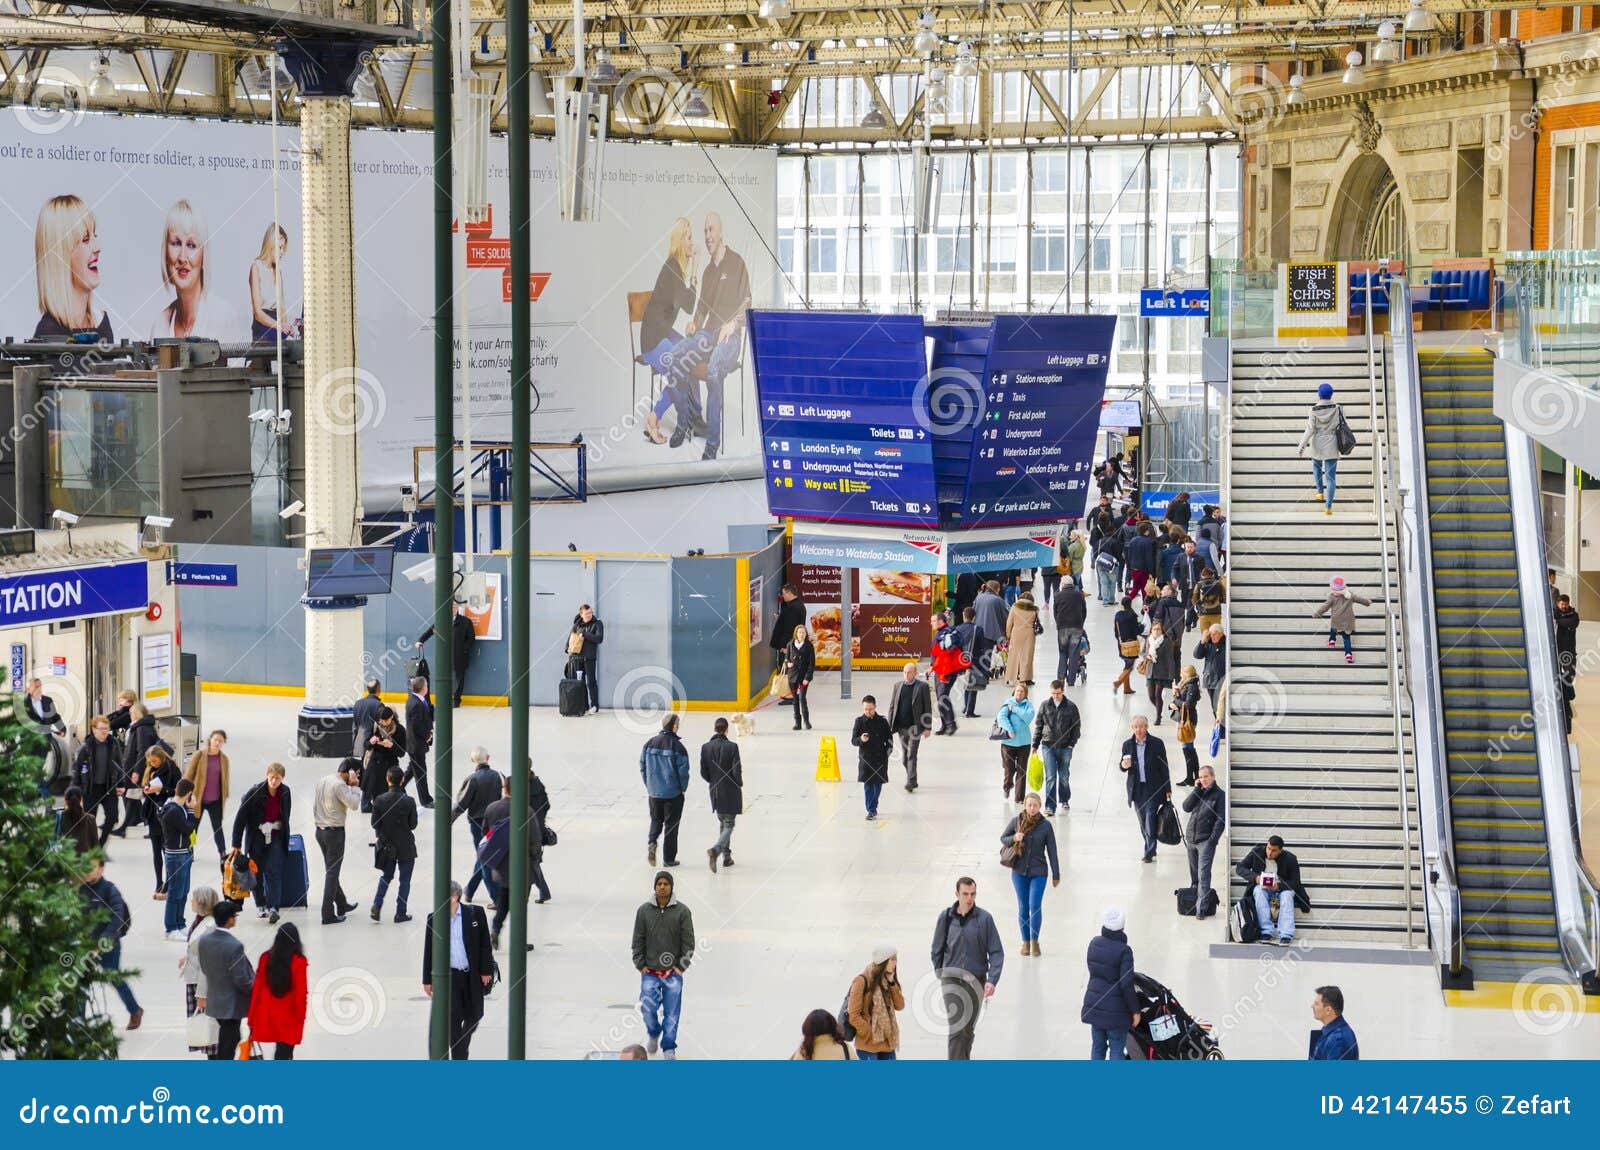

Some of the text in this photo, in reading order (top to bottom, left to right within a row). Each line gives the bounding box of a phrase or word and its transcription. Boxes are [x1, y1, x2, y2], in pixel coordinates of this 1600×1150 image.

[36, 149, 44, 159] a
[48, 145, 91, 161] soldier
[94, 151, 107, 162] or
[110, 147, 151, 164] former
[153, 150, 196, 168] soldier,
[199, 156, 206, 166] a
[208, 157, 250, 171] spouse,
[252, 158, 259, 169] a
[369, 164, 380, 174] or
[382, 160, 422, 177] brother,
[619, 168, 637, 184] help
[471, 247, 512, 259] THE SOLDIE
[1298, 269, 1327, 280] FISH
[1307, 279, 1317, 289] &
[1293, 289, 1331, 300] CHIPS
[475, 340, 492, 353] your
[495, 338, 513, 350] Arm
[1047, 355, 1084, 367] Left Luggage
[1016, 374, 1062, 385] Station reception
[1012, 392, 1026, 402] Taxis
[800, 407, 851, 419] Left Luggage
[1008, 411, 1046, 421] First aid point
[869, 427, 895, 438] Toilets
[1005, 429, 1042, 440] Underground
[801, 443, 861, 456] London Eye Pier
[1003, 446, 1061, 457] Waterloo East Station
[802, 461, 851, 473] Underground
[1025, 463, 1070, 475] London Eye Pier
[804, 479, 822, 491] Way
[823, 480, 837, 490] out
[1049, 481, 1066, 490] Toilets
[870, 500, 899, 512] Tickets
[994, 501, 1051, 513] Car park and Car hire
[1146, 499, 1169, 509] Lef
[799, 544, 914, 562] Welcome to Waterloo Station
[952, 549, 1037, 564] Welcome to Waterloo Station
[802, 568, 814, 577] just
[0, 580, 82, 614] TATION
[872, 615, 920, 624] freshly baked
[882, 626, 910, 634] pastries
[895, 635, 908, 644] day
